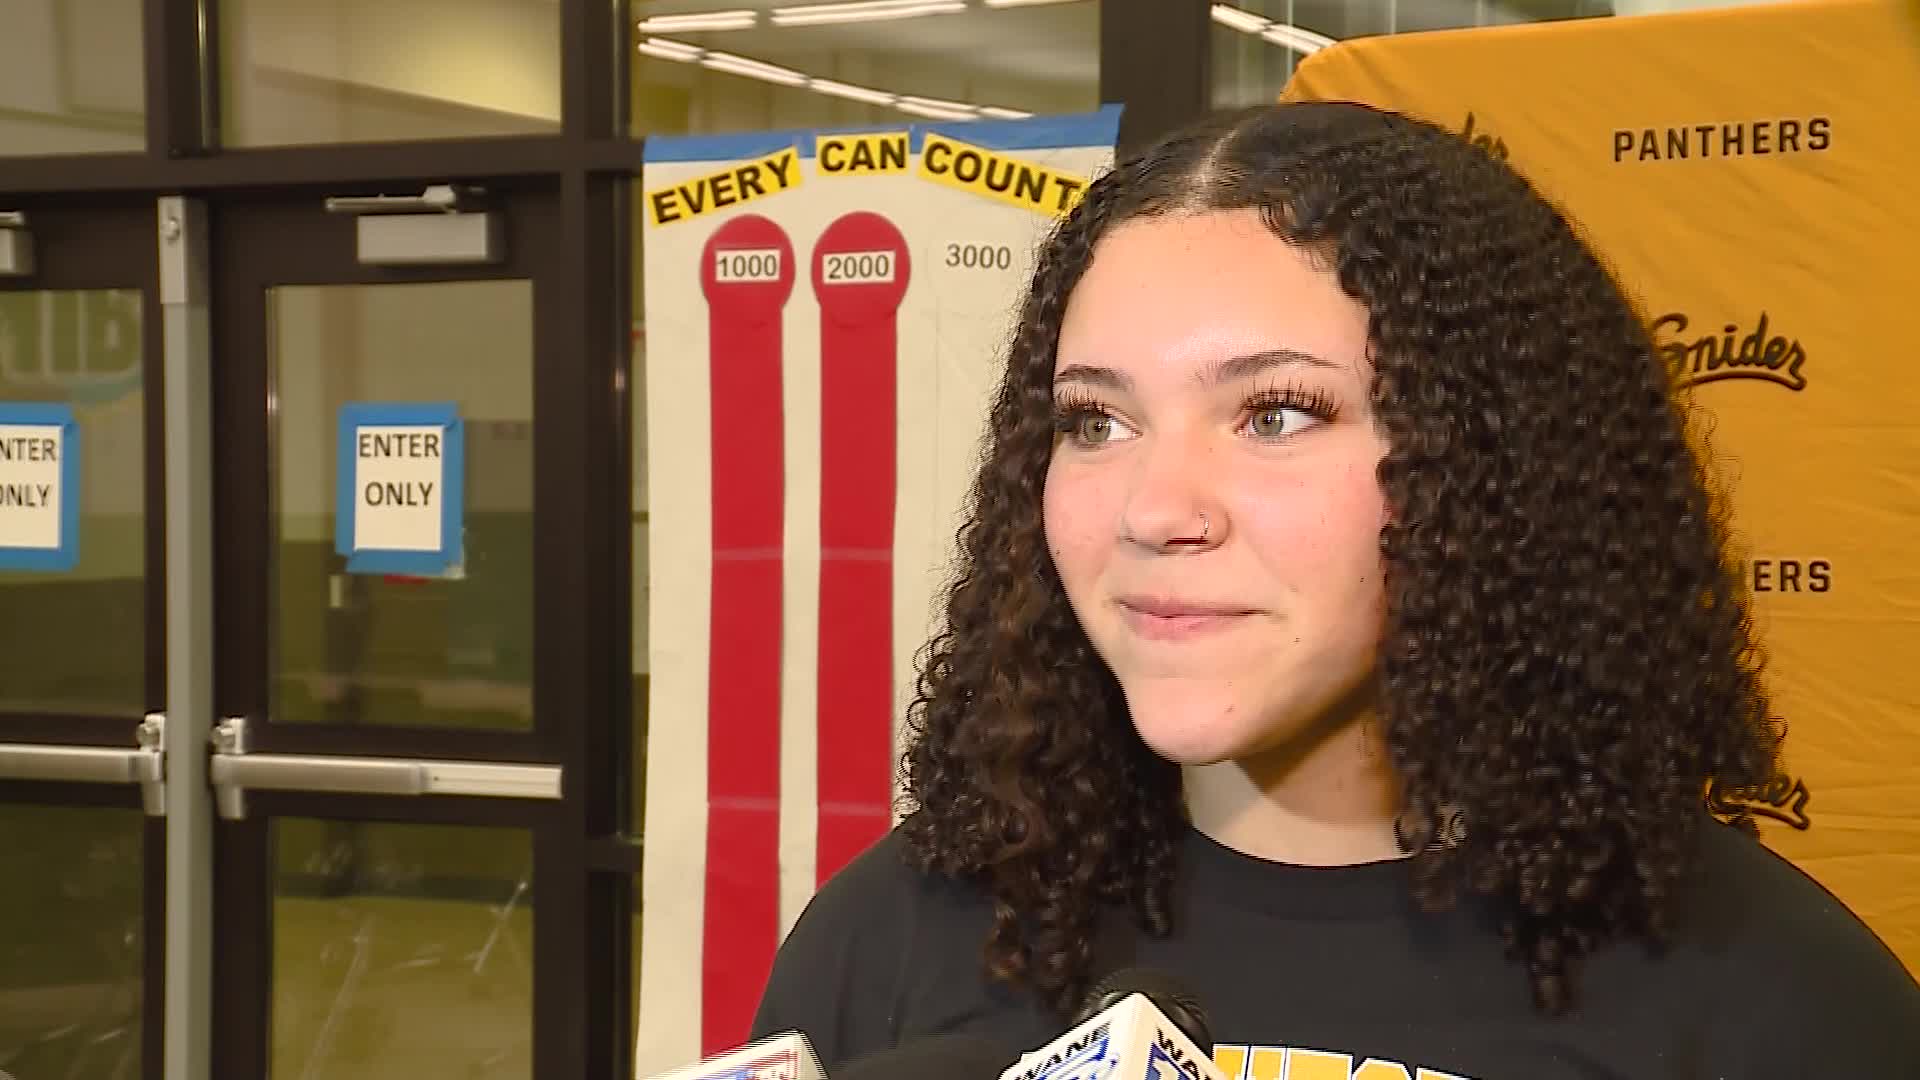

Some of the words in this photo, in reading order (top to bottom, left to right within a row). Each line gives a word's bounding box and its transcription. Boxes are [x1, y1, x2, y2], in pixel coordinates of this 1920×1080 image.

[1613, 117, 1832, 162] PANTHERS
[651, 154, 794, 225] EVERY
[819, 137, 908, 173] CAN
[924, 141, 1084, 211] COUNT
[717, 254, 778, 278] 1000
[827, 255, 891, 280] 2000
[945, 244, 1012, 271] 3000
[359, 433, 440, 458] ENTER
[0, 484, 50, 507] NLY
[365, 481, 433, 506] ONLY
